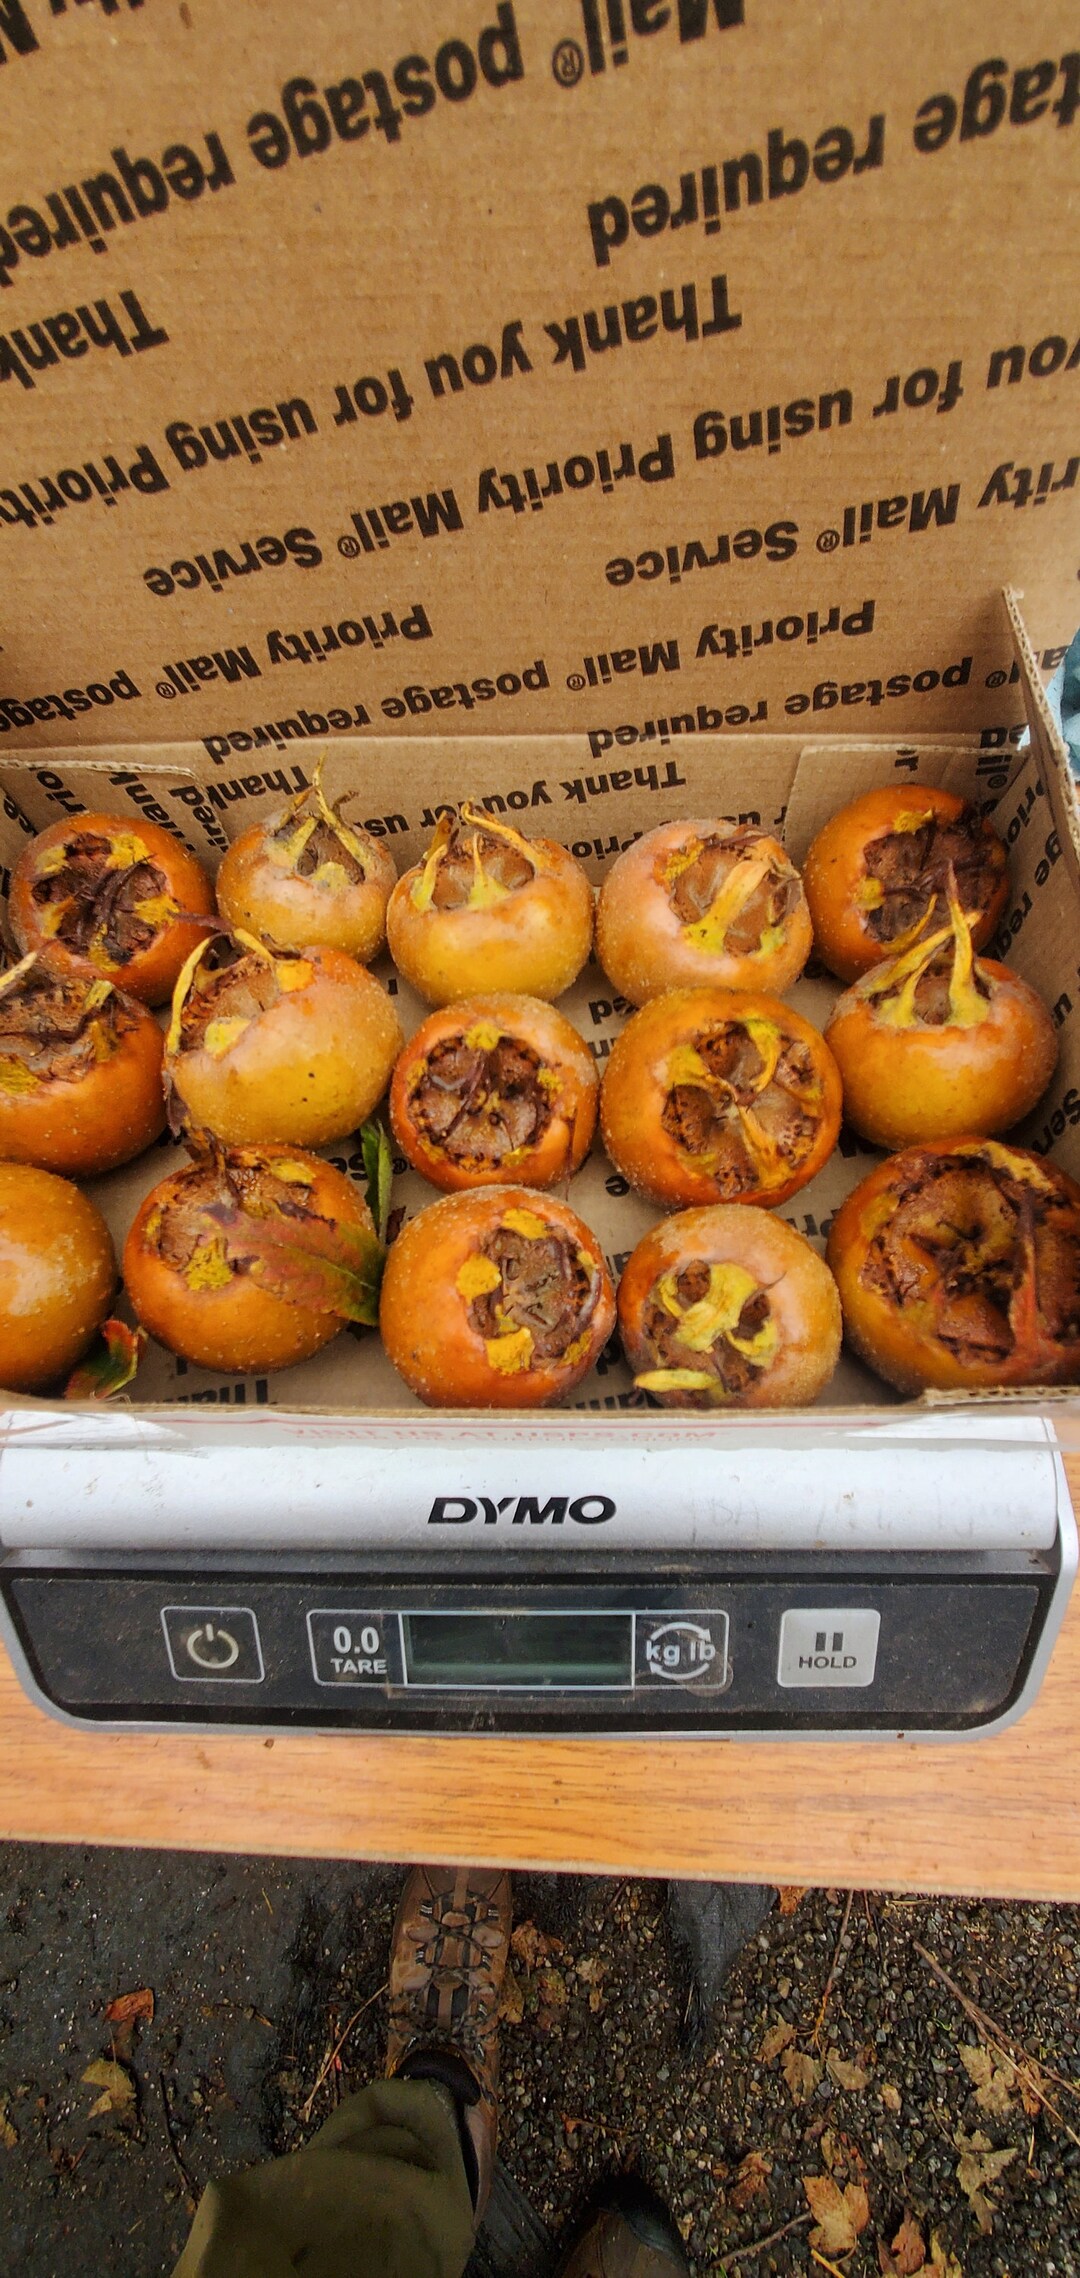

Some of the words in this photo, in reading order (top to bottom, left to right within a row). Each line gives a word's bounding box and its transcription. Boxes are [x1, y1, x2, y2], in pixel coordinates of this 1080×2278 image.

[246, 2, 524, 170] postage
[587, 114, 885, 269] required
[544, 275, 742, 373] Thank
[424, 320, 533, 399] you
[332, 368, 414, 427] for
[873, 360, 963, 420] for
[164, 397, 318, 472] using
[692, 390, 853, 461] using
[0, 444, 171, 531] Priorit
[478, 433, 675, 514] Priority
[337, 489, 464, 559] Mail®
[816, 483, 961, 554] Mail®
[142, 527, 323, 598] Service
[604, 521, 800, 589] Service
[267, 604, 433, 667] Priority
[695, 600, 875, 659] Priority
[155, 644, 263, 700] Mail®
[380, 661, 550, 720] postage
[566, 640, 680, 691] Mail®
[785, 657, 973, 716] postage
[200, 704, 371, 765] required
[586, 700, 768, 758] required
[481, 780, 553, 815] you
[560, 760, 686, 804] Thank
[419, 803, 467, 830] or
[427, 1495, 616, 1525] DYMO
[330, 1657, 388, 1675] TARE
[333, 1626, 379, 1654] 0.0
[646, 1640, 680, 1666] kg
[690, 1640, 716, 1661] lb
[798, 1655, 858, 1669] HOLD
